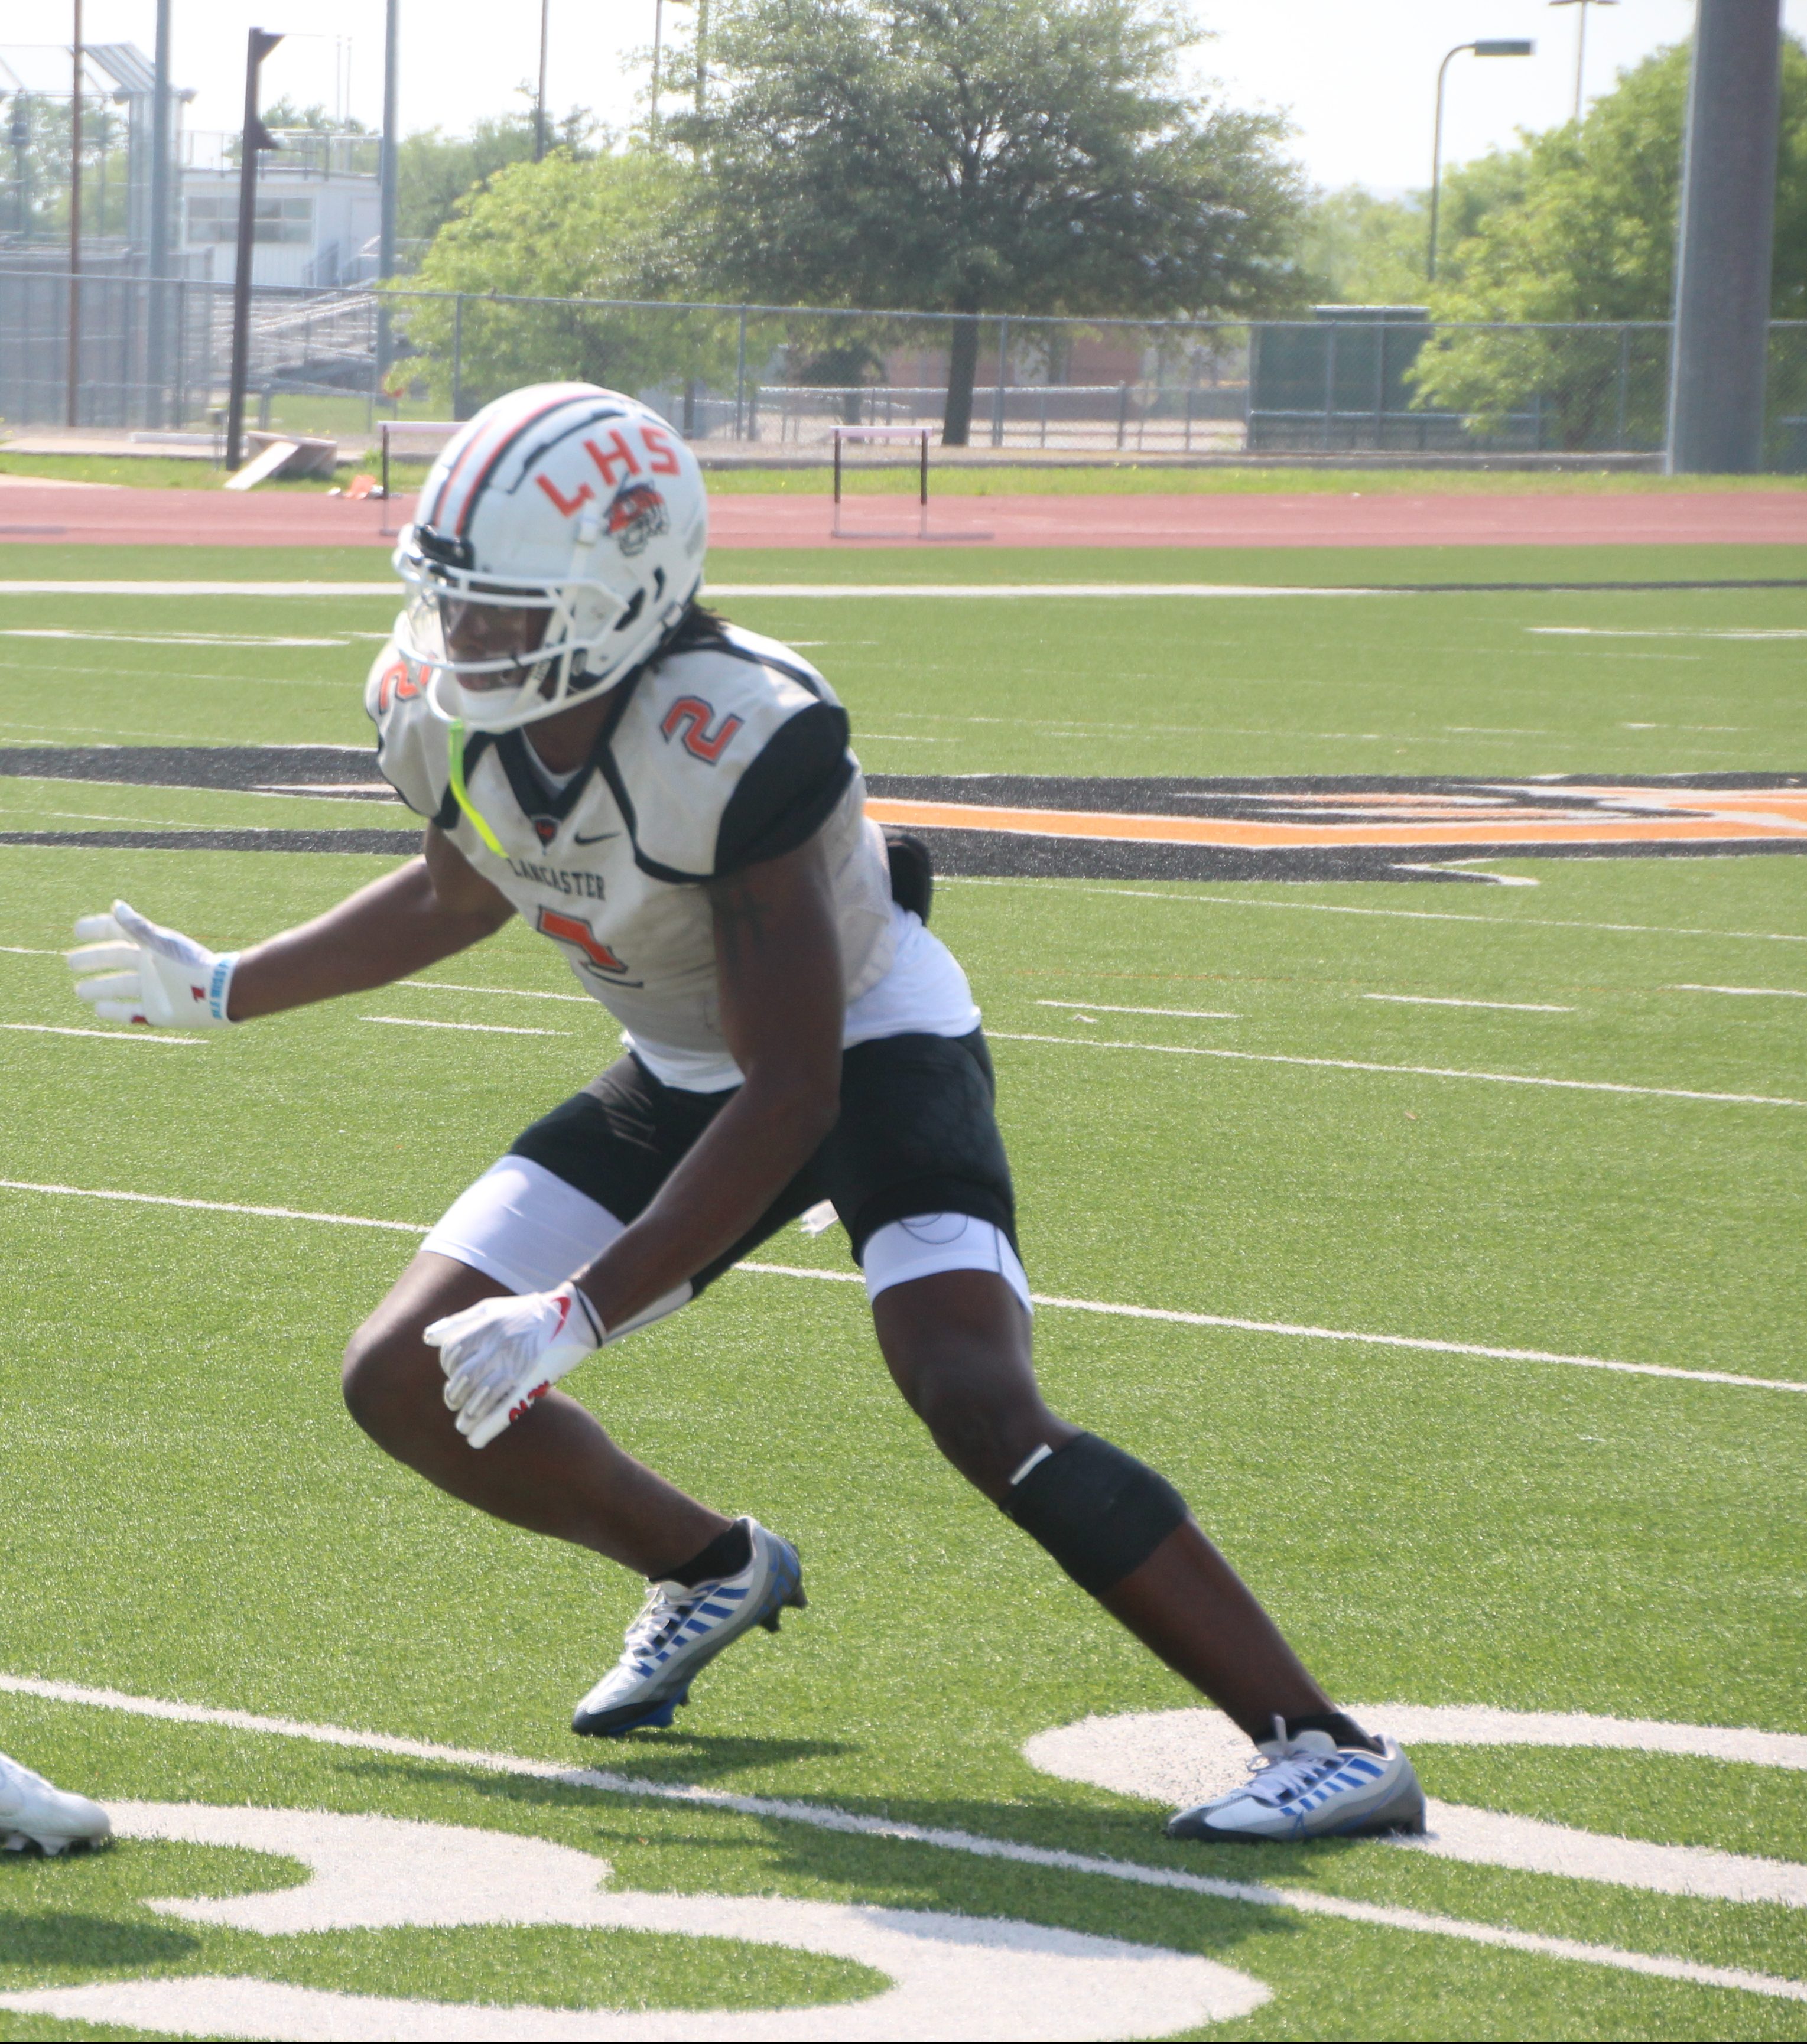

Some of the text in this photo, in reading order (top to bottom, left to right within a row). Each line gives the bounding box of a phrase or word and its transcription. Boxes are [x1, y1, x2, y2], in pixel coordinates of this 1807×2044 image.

[535, 425, 681, 518] LHS
[659, 694, 745, 767] 2
[506, 858, 607, 901] LANCASTER
